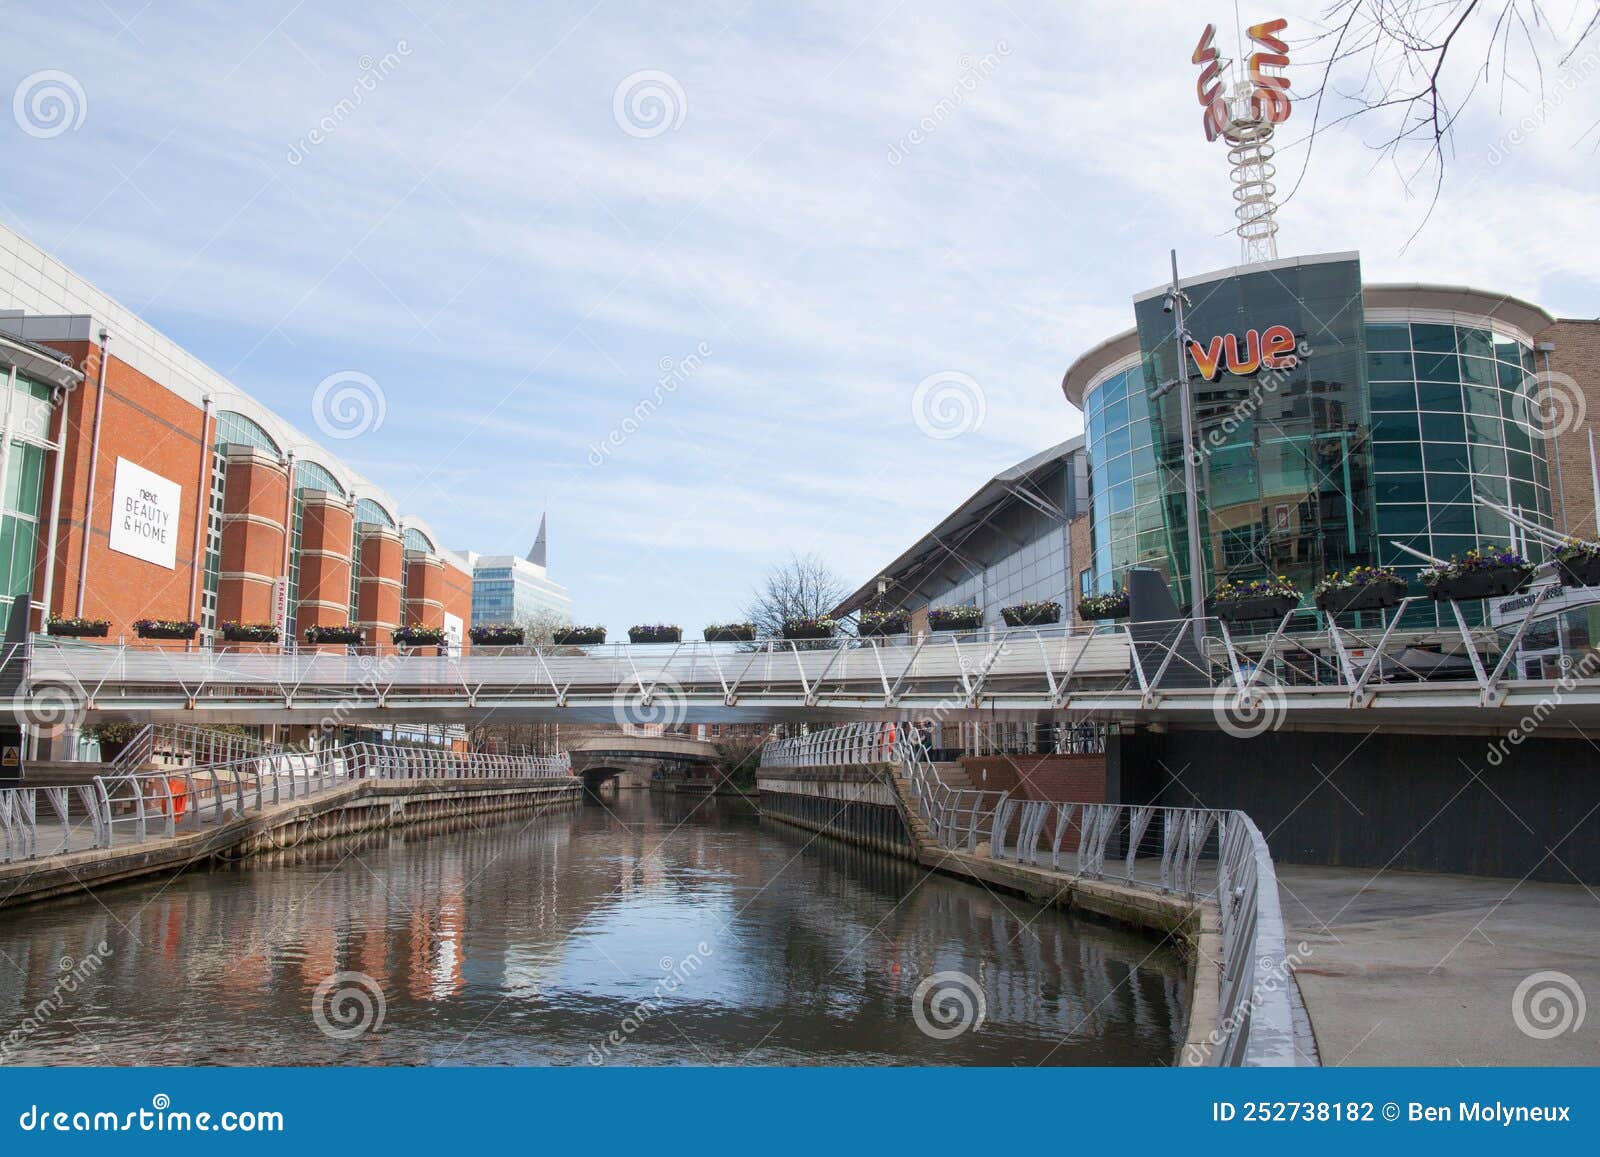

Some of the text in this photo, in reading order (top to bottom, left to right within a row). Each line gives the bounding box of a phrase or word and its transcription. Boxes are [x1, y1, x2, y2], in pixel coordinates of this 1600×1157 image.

[1191, 23, 1229, 142] vue
[1246, 18, 1292, 124] vue
[1188, 325, 1297, 381] vue
[125, 496, 169, 527] BEAUTY
[139, 488, 159, 505] next
[124, 515, 167, 545] & HOME
